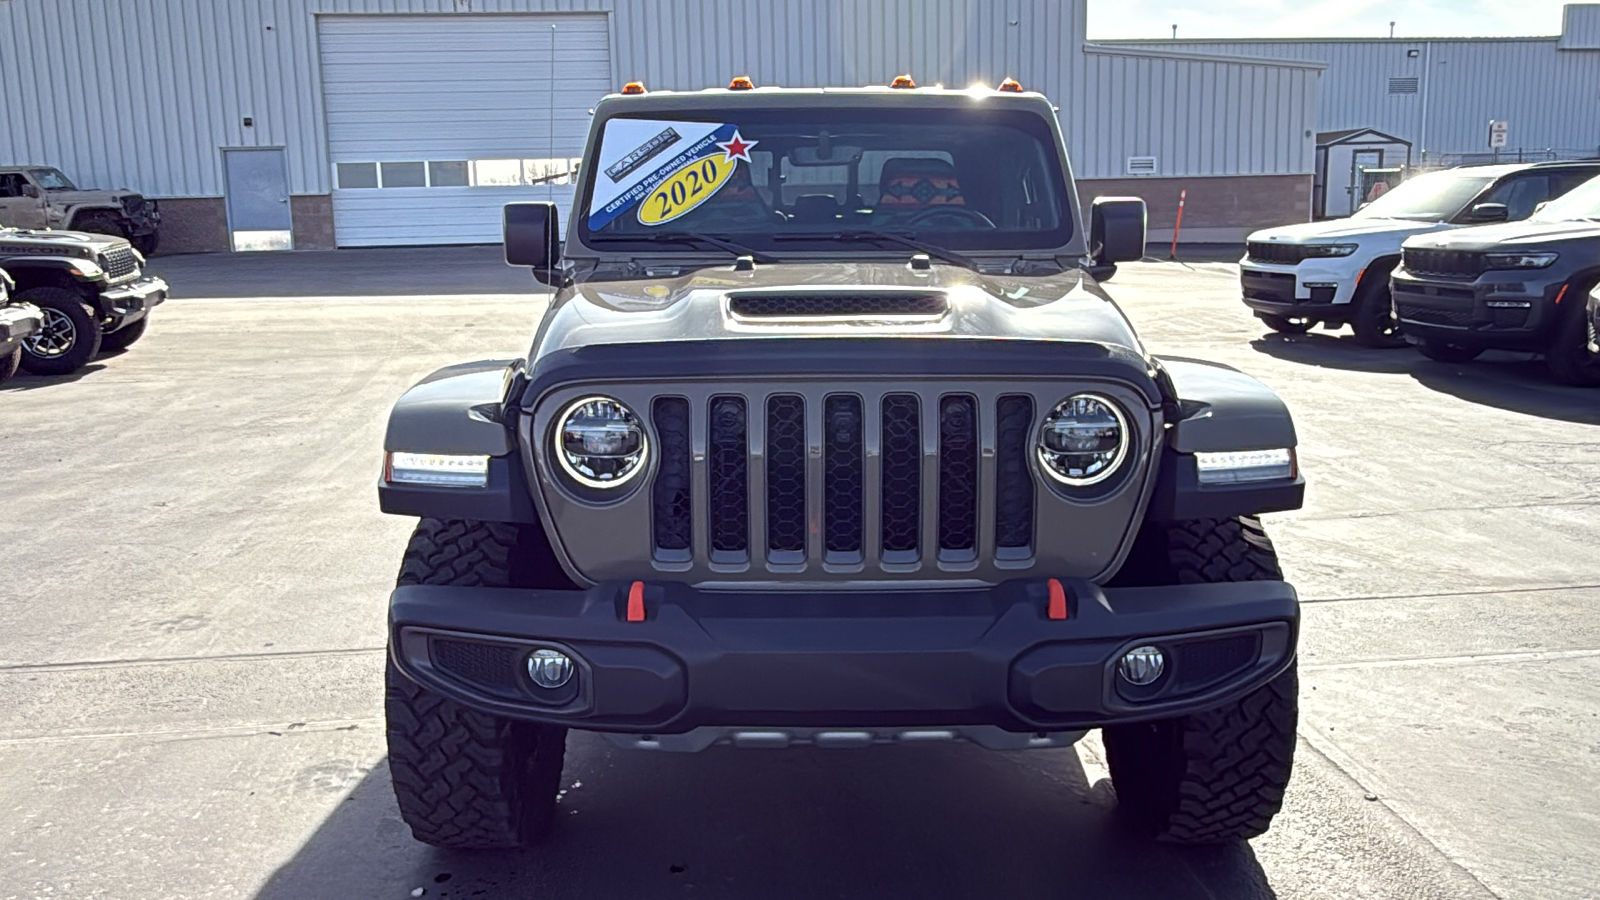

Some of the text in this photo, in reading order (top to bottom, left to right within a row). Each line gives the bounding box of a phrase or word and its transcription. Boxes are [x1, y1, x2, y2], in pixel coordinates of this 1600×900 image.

[605, 184, 644, 214] CERTIFIED
[643, 154, 686, 187] PRE-OWNED
[685, 134, 717, 158] VEHICLE
[609, 130, 673, 176] CARSON
[634, 191, 646, 201] ASK
[655, 159, 717, 219] 2020
